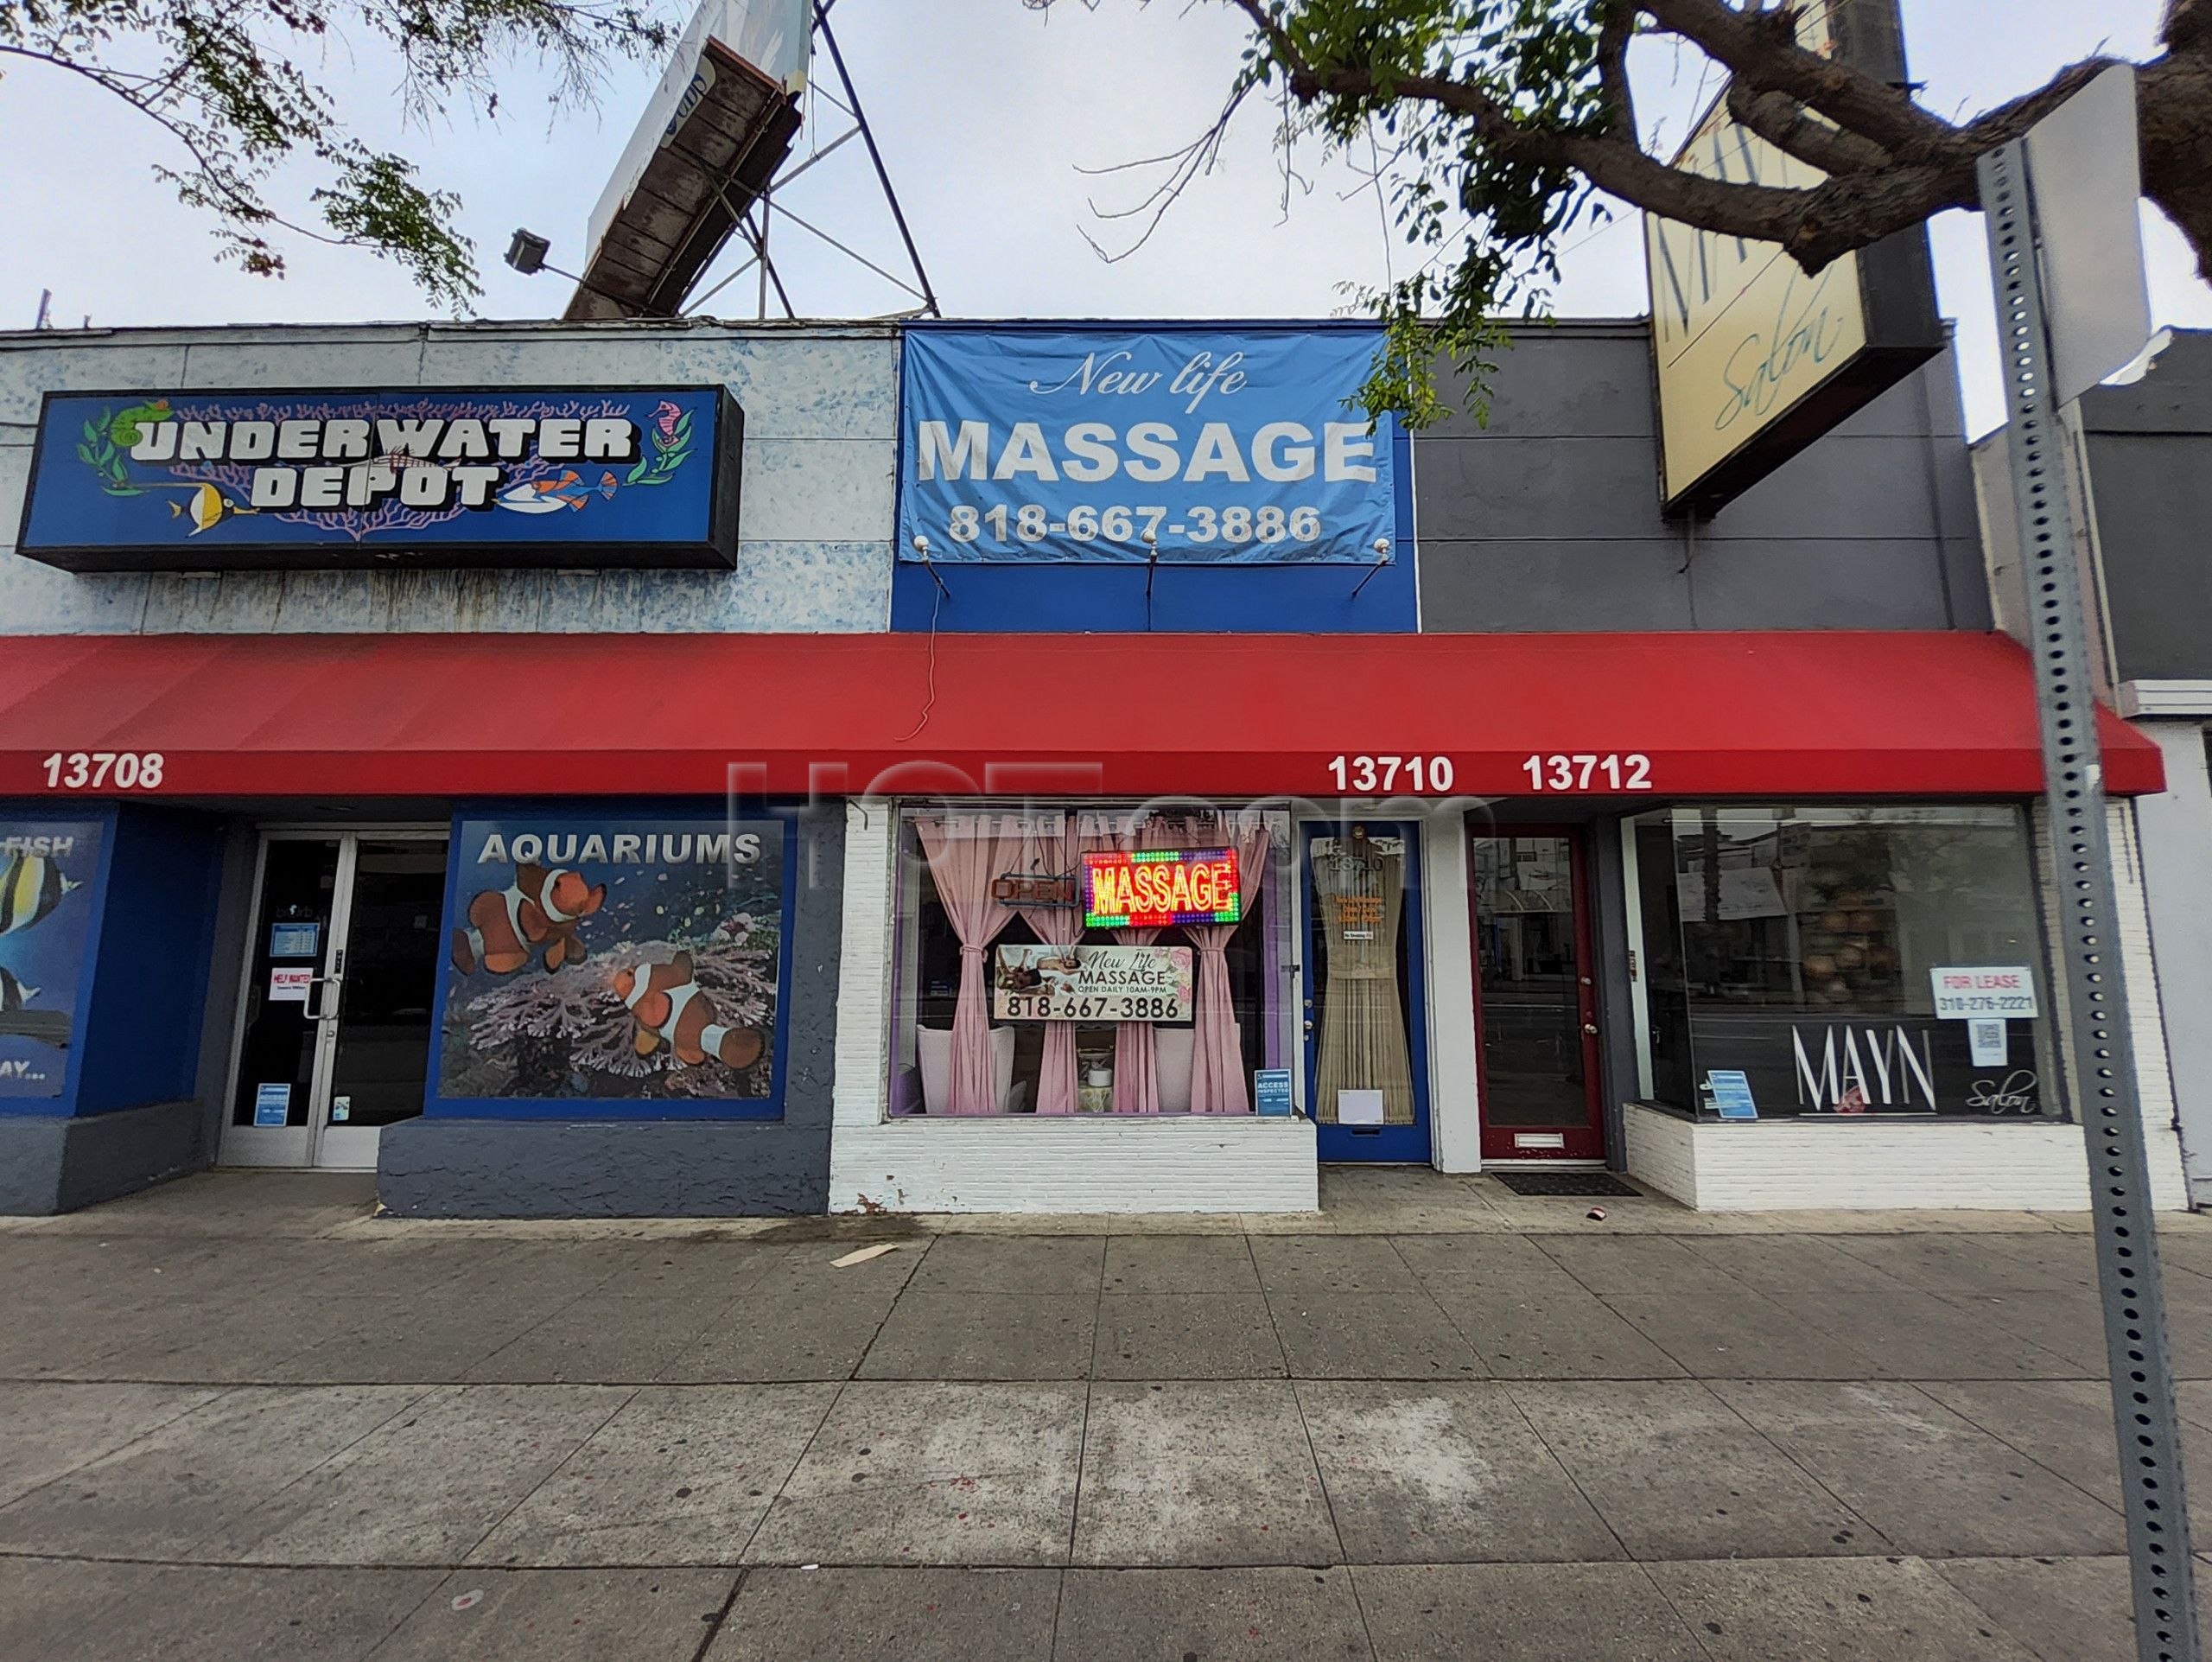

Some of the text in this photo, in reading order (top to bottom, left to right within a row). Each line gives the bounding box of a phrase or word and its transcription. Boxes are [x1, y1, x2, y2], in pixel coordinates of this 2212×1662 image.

[1029, 351, 1249, 415] New life
[130, 418, 634, 462] UNDERWATER
[918, 420, 1376, 484] MASSAGE
[250, 465, 499, 507] DEPOT
[949, 504, 1321, 544] 818-667-3886
[43, 752, 164, 788] 13708
[1327, 755, 1453, 792] 13710
[1522, 754, 1653, 790] 13712
[3, 836, 74, 858] FISH
[477, 833, 762, 865] AQUARIUMS
[991, 877, 1075, 902] OPEN
[1092, 863, 1233, 914] MASSAGE
[1078, 971, 1166, 985] MASSAGE
[1088, 949, 1157, 973] New Life
[1944, 975, 2020, 989] FOR LEASE
[1007, 997, 1179, 1018] 818-667-3886
[1792, 1024, 1936, 1111] MAYN
